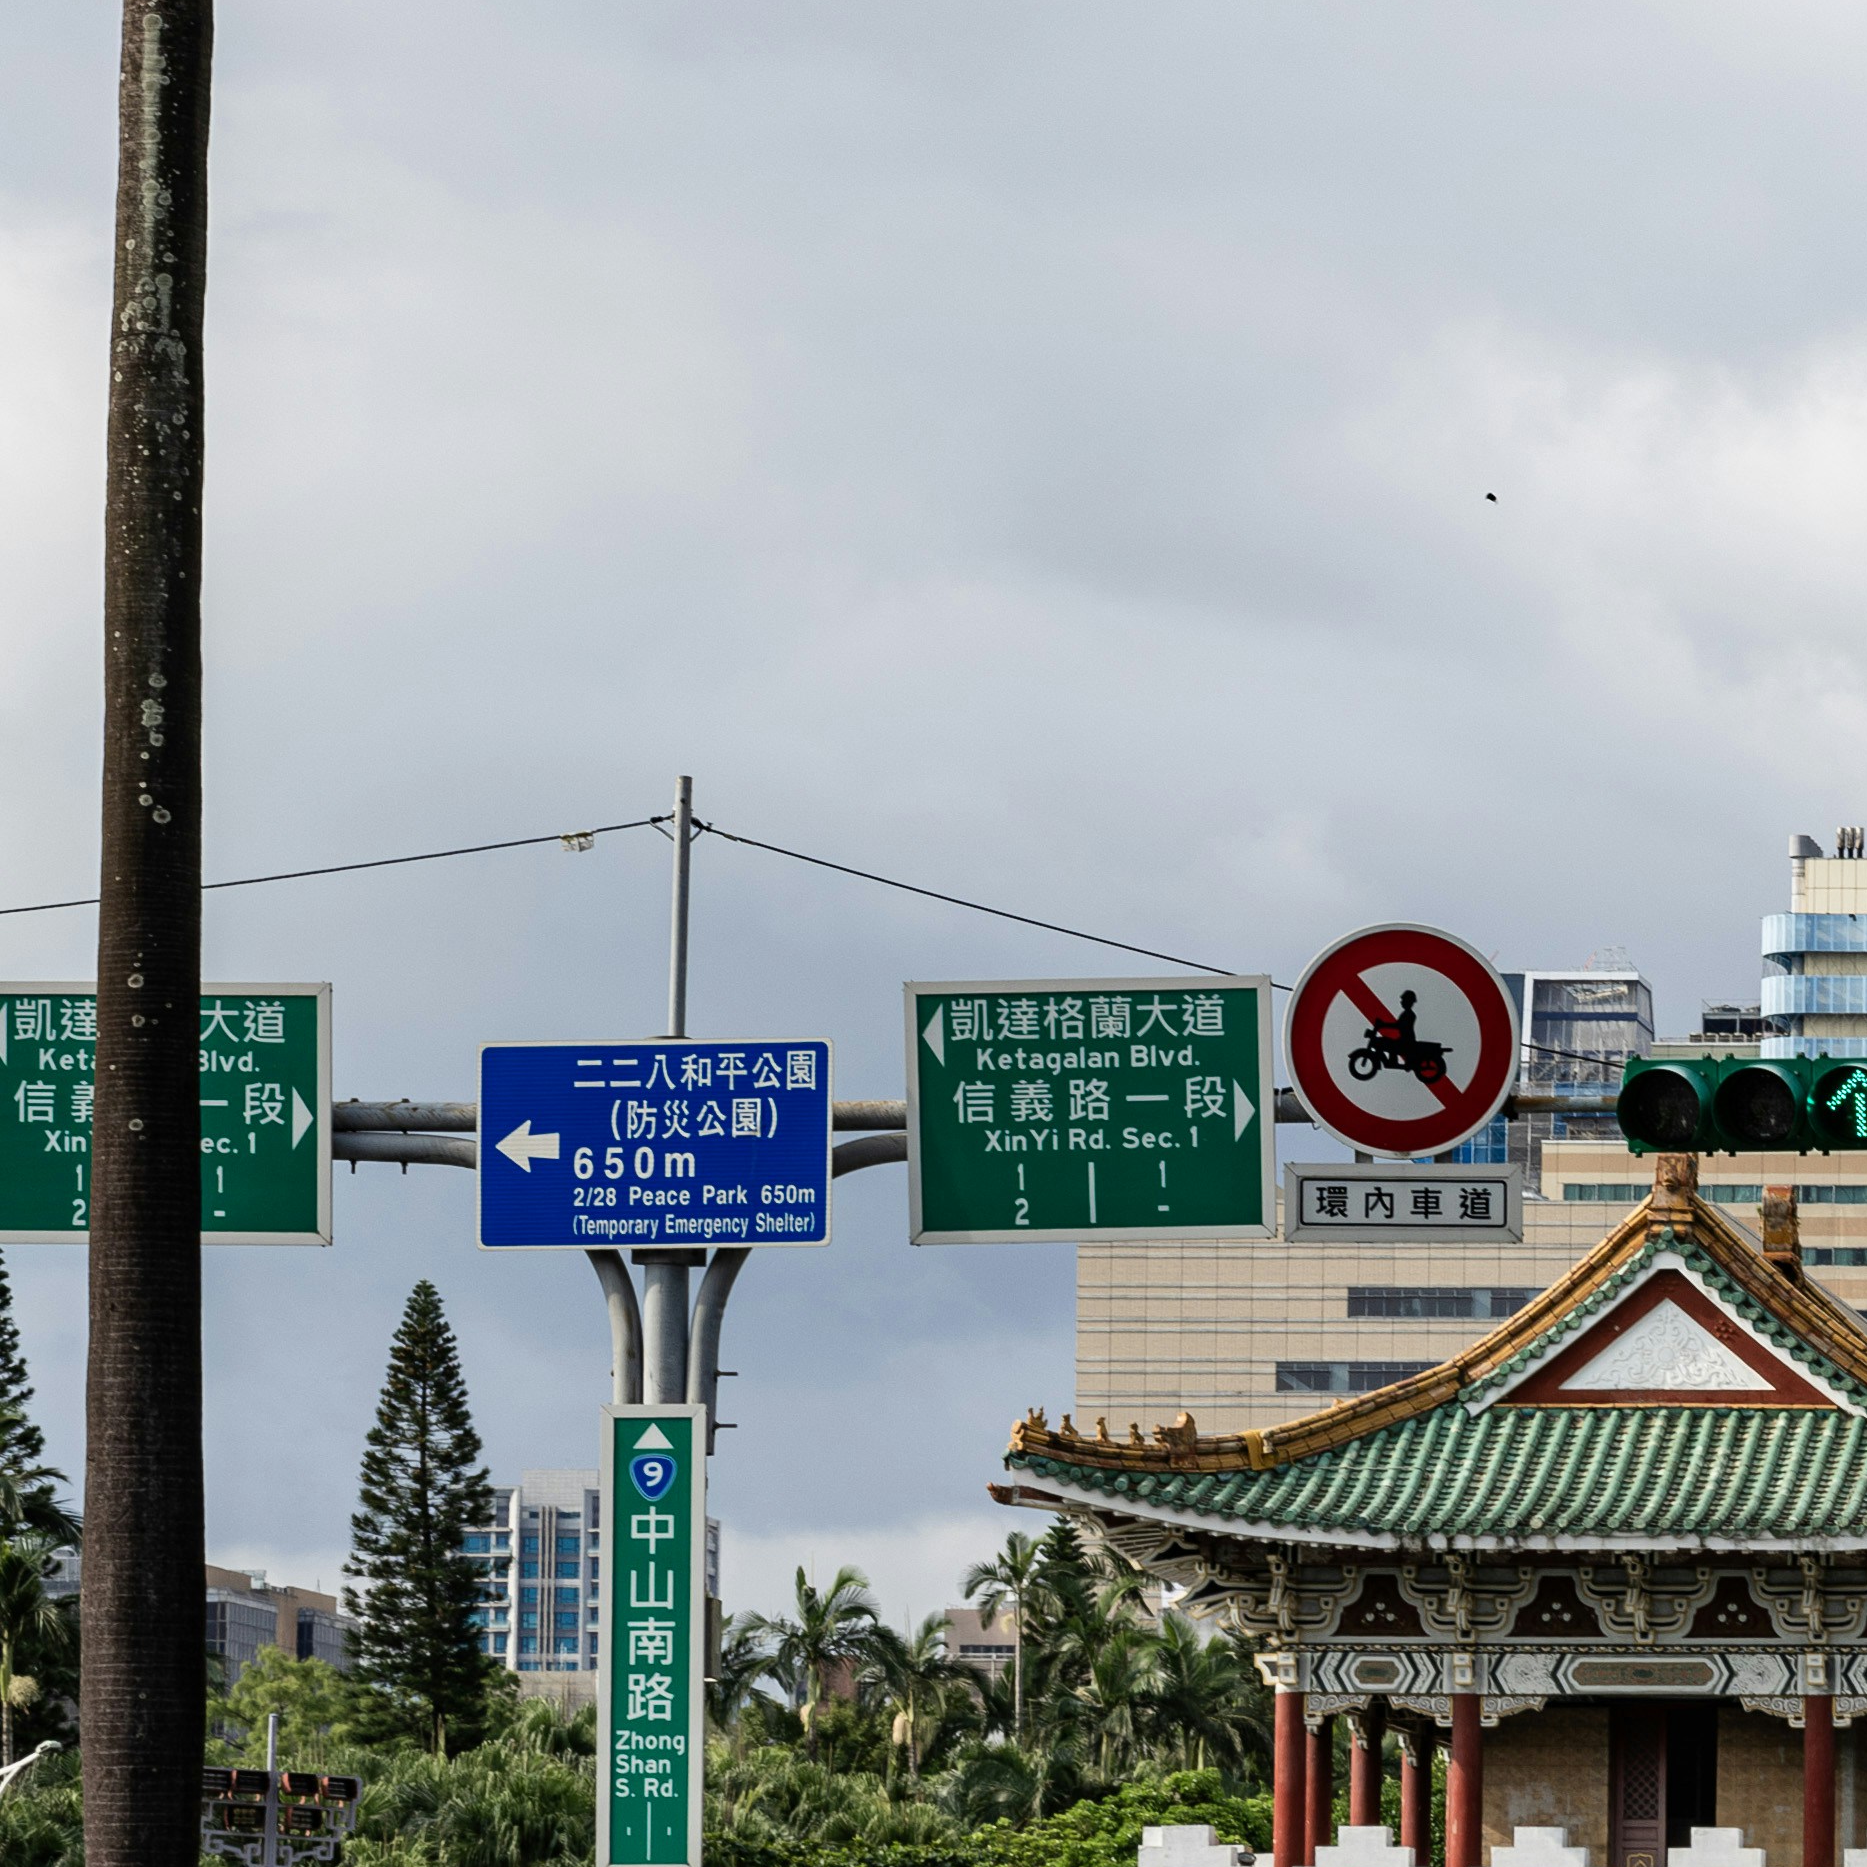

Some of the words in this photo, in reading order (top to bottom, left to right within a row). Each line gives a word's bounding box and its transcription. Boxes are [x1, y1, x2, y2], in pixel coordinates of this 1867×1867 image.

[14, 998, 285, 1043] 凱達大道
[950, 994, 1225, 1042] 凱達格蘭大道
[573, 1050, 817, 1091] 二二八和平公園
[977, 1047, 1119, 1075] Ketagalan
[1130, 1045, 1200, 1068] Blvd.
[953, 1076, 1227, 1124] 信義路一段
[248, 1132, 256, 1154] 1
[985, 1129, 1059, 1152] XinYi
[1068, 1128, 1111, 1150] Rd.
[1122, 1127, 1181, 1149] Sec.
[1189, 1126, 1199, 1148] 1
[573, 1187, 617, 1208] 2/28
[629, 1186, 691, 1206] Peace
[702, 1185, 748, 1205] Park
[761, 1184, 815, 1204] 650m
[1316, 1186, 1492, 1220] 環內車道
[71, 1198, 87, 1226] 2
[573, 1214, 659, 1239] (Temporary
[665, 1213, 749, 1238] Emergency
[755, 1212, 816, 1234] Shelter)
[1014, 1198, 1030, 1226] 2
[642, 1461, 662, 1487] 9
[626, 1506, 676, 1721] 中山南路
[615, 1730, 686, 1755] Zhong
[615, 1754, 671, 1774] Shan
[615, 1778, 635, 1798] S.
[644, 1778, 679, 1798] Rd.
